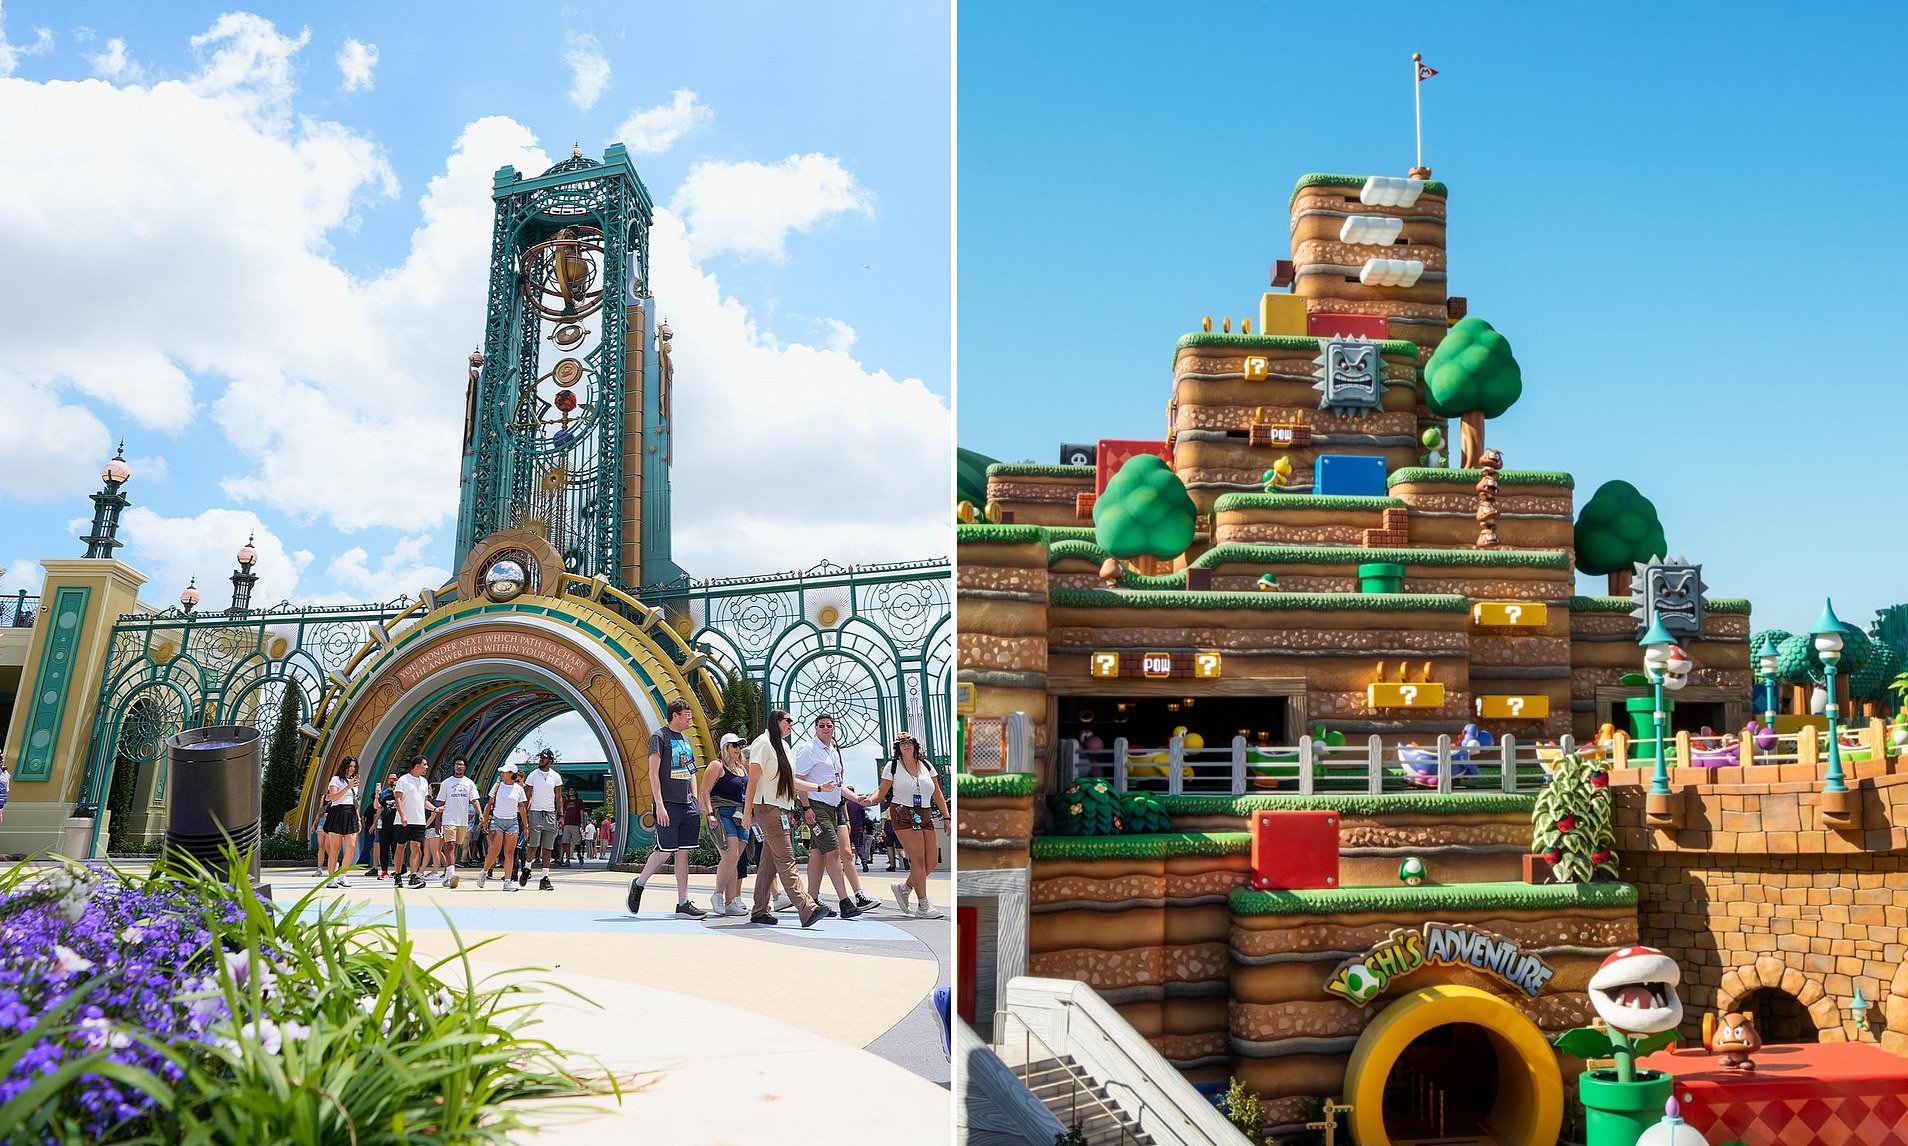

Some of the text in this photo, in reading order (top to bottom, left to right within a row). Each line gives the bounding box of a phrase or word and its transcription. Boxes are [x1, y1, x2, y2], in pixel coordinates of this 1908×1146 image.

[1251, 358, 1265, 374] ?
[1271, 429, 1292, 441] POW
[1505, 605, 1522, 624] ?
[400, 634, 587, 679] YOU WONDER NEXT WHICH PATH TO CHART
[411, 643, 576, 681] THE ANSWER LIES WITHIN YOUR HEART
[1096, 655, 1115, 675] ?
[1144, 658, 1170, 673] POW
[1199, 655, 1217, 675] ?
[1399, 685, 1418, 705] ?
[1506, 697, 1524, 716] ?
[1328, 927, 1554, 1001] YOSHI'S ADVENTURE
